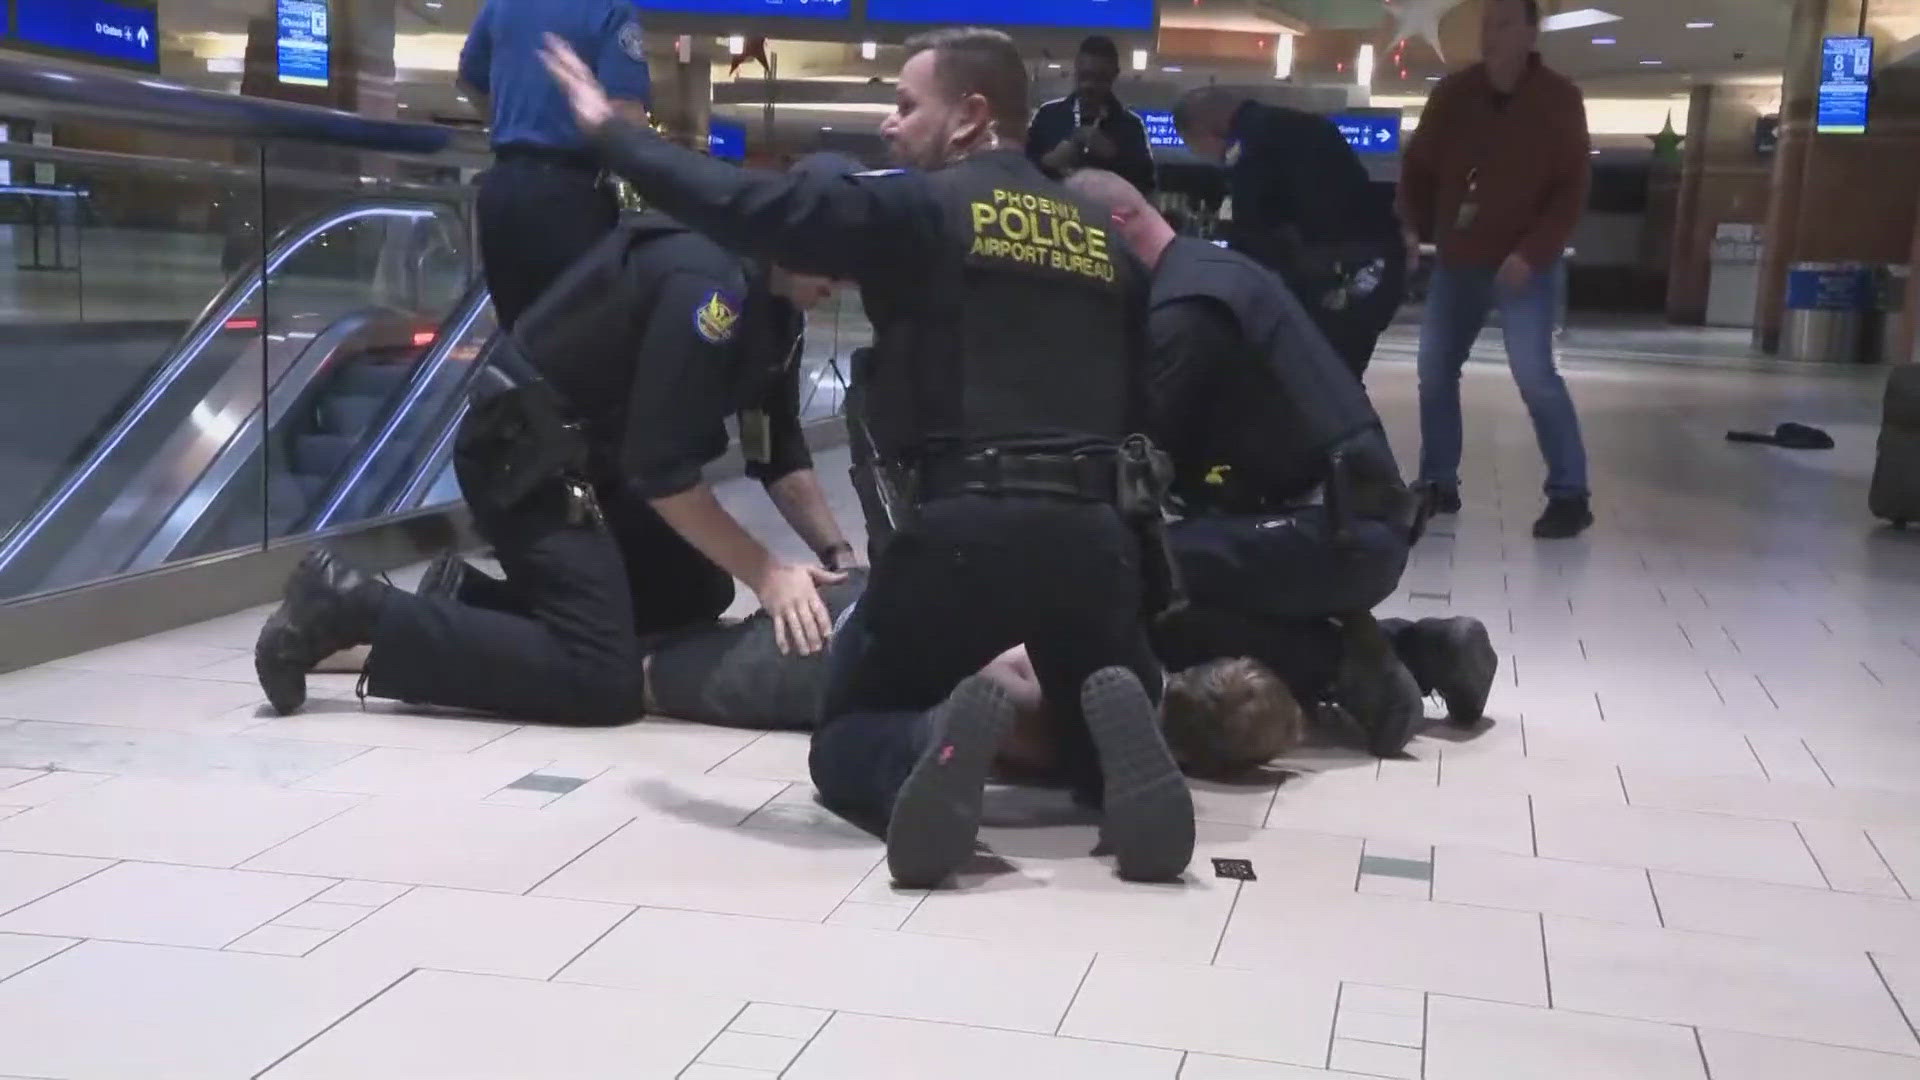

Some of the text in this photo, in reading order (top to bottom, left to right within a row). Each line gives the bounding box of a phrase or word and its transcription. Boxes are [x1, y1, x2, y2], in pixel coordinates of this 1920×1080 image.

[1833, 54, 1845, 71] 8
[993, 188, 1081, 221] PHOENIX
[970, 202, 1109, 261] POLICE
[969, 235, 1115, 283] AIRPORT BUREAU
